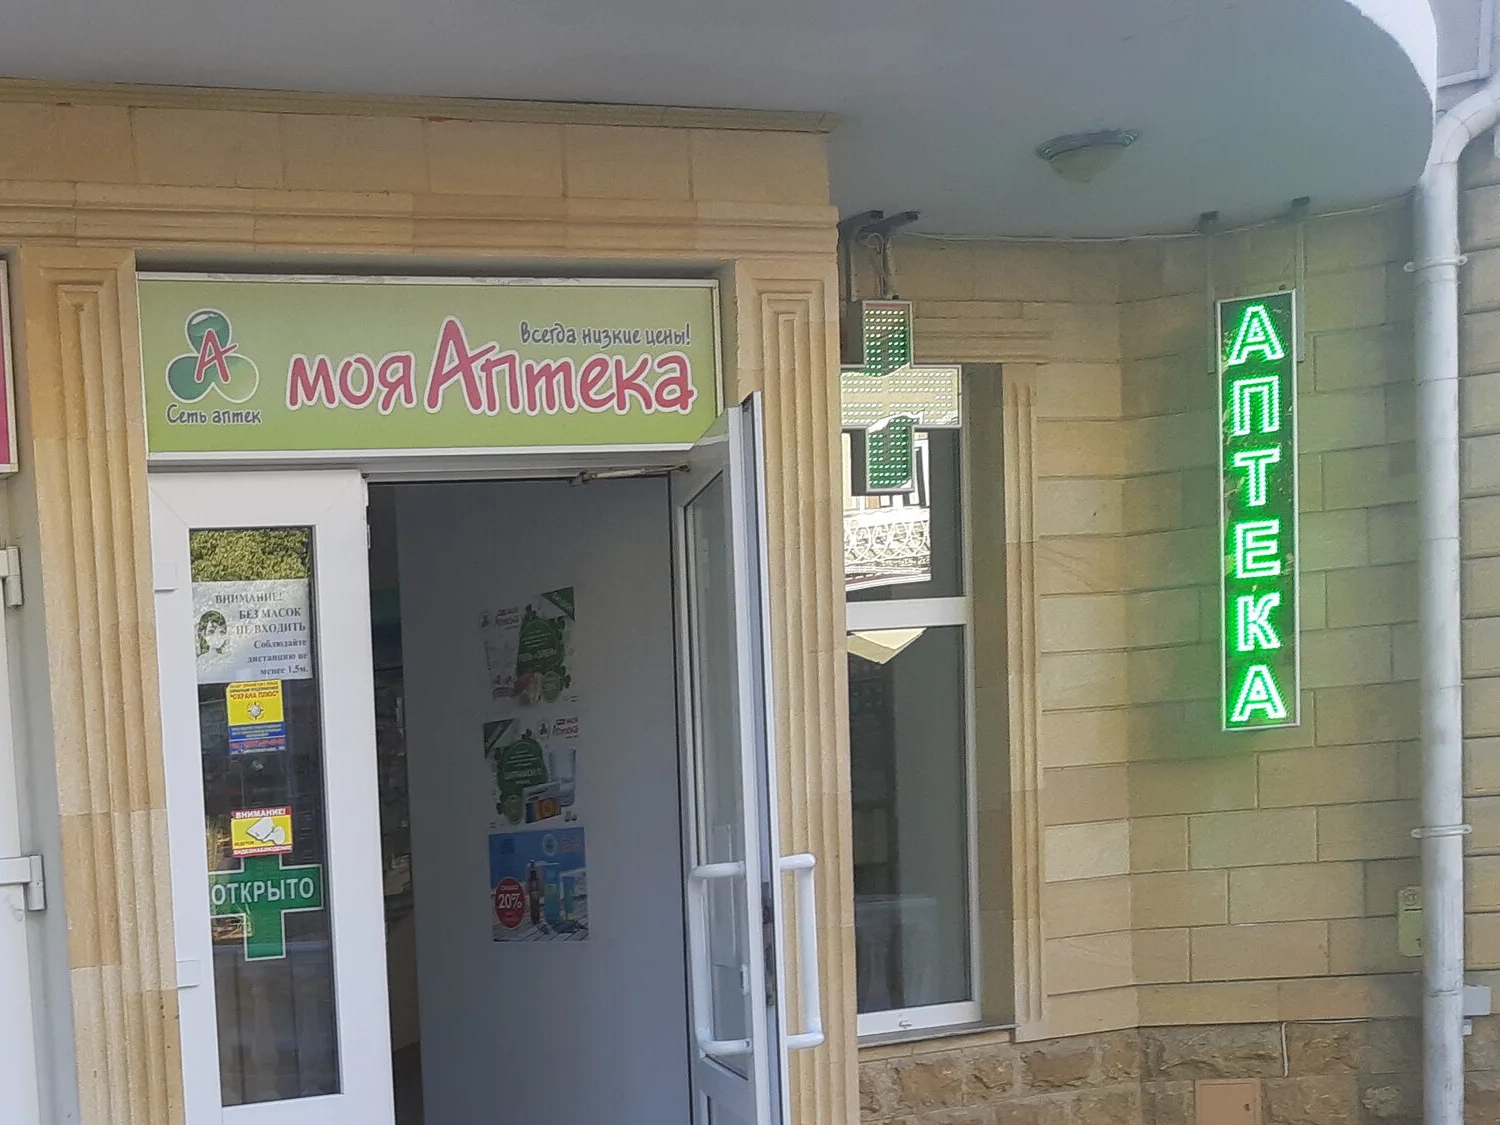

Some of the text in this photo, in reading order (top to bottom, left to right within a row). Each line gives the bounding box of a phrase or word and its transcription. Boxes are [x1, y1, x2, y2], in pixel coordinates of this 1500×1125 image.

[520, 321, 692, 347] Всегда низкие цены!
[288, 318, 695, 413] моя Аптека
[167, 403, 262, 425] Сеть аптек
[1228, 305, 1287, 722] АПТЕКА
[215, 592, 283, 604] ВНИМАНИЕ!
[239, 607, 302, 620] БЕЗ МАСОК
[254, 622, 306, 634] ВХОДИТЬ
[253, 638, 307, 649] Соблюдайте
[235, 808, 286, 819] ВНИМАНИЕ!
[211, 876, 315, 906] ОТКРЫТО
[498, 893, 523, 909] 20%
